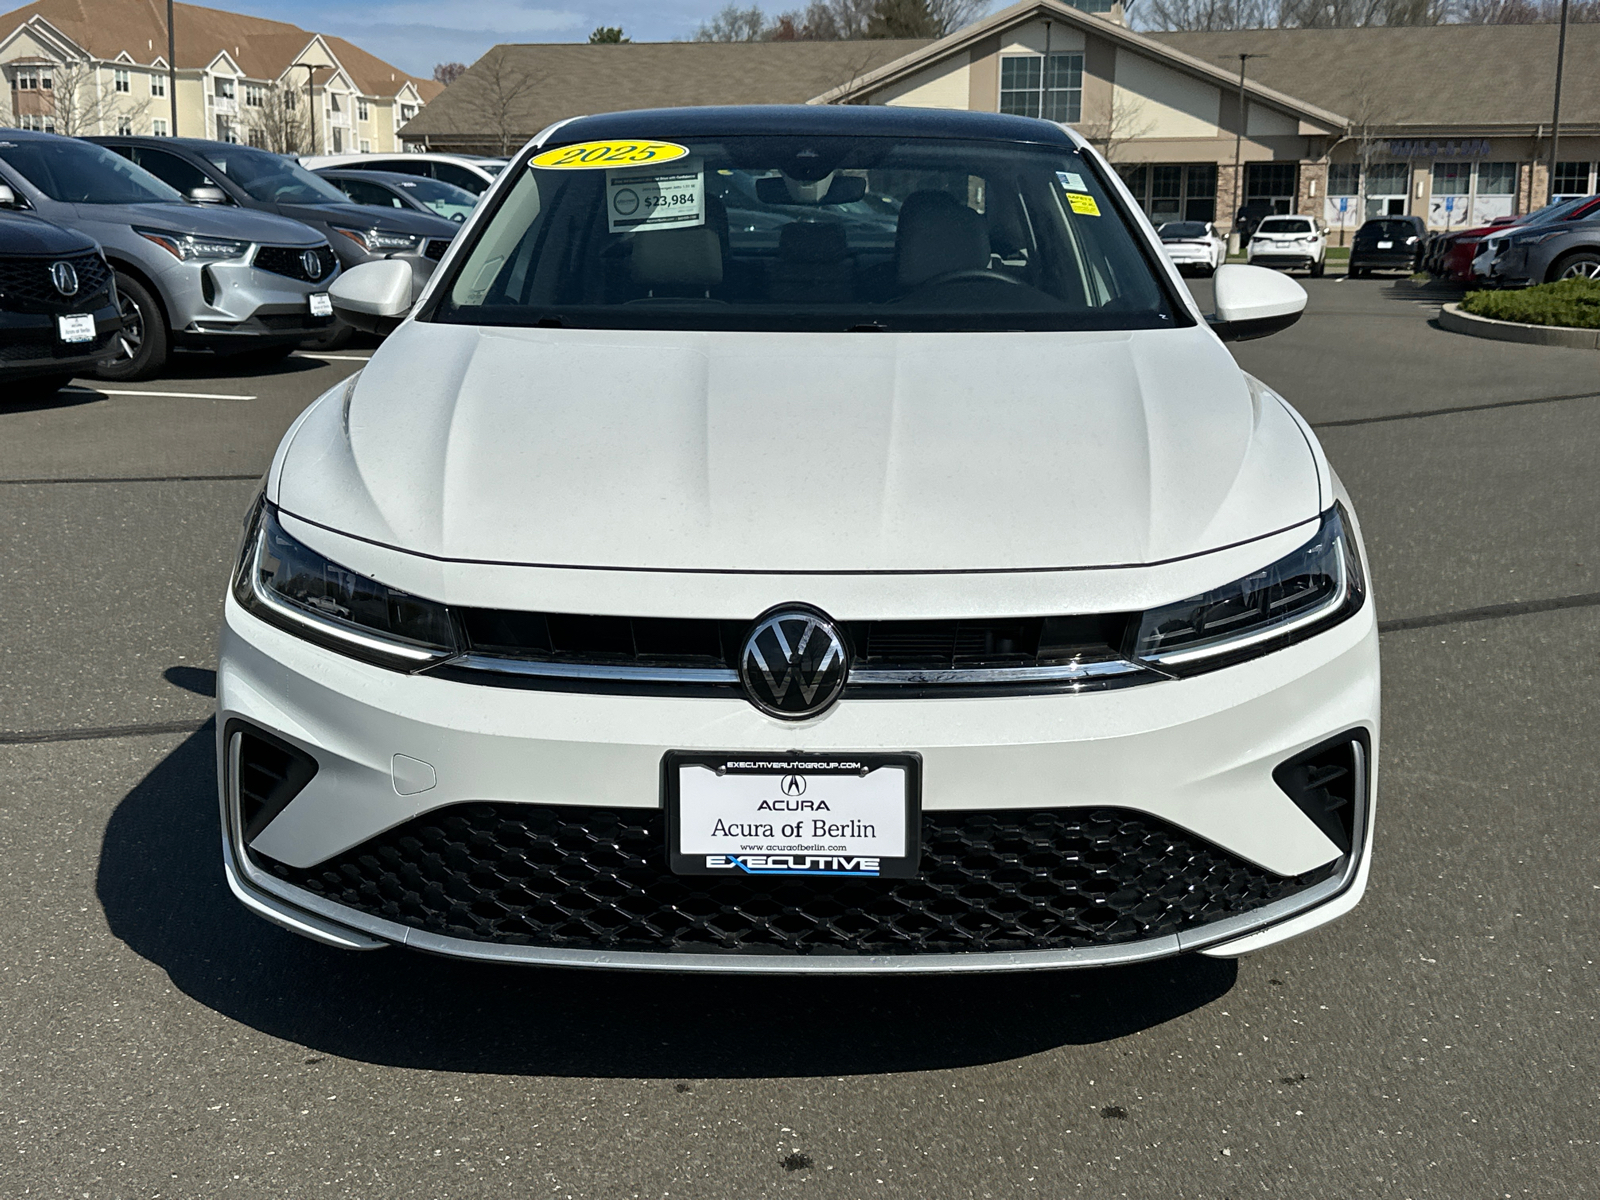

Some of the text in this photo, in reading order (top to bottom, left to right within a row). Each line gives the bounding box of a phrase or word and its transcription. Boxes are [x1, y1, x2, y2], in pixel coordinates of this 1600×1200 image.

[551, 145, 666, 166] 2025
[644, 193, 695, 209] $23,984
[726, 761, 861, 770] EXECUTIVEAUTOGROUP.COM
[757, 800, 831, 812] ACURA
[711, 818, 877, 839] Acura of Berlin
[740, 842, 848, 853] www.acuraofberlin.com
[705, 854, 881, 872] EXECUTIVE
